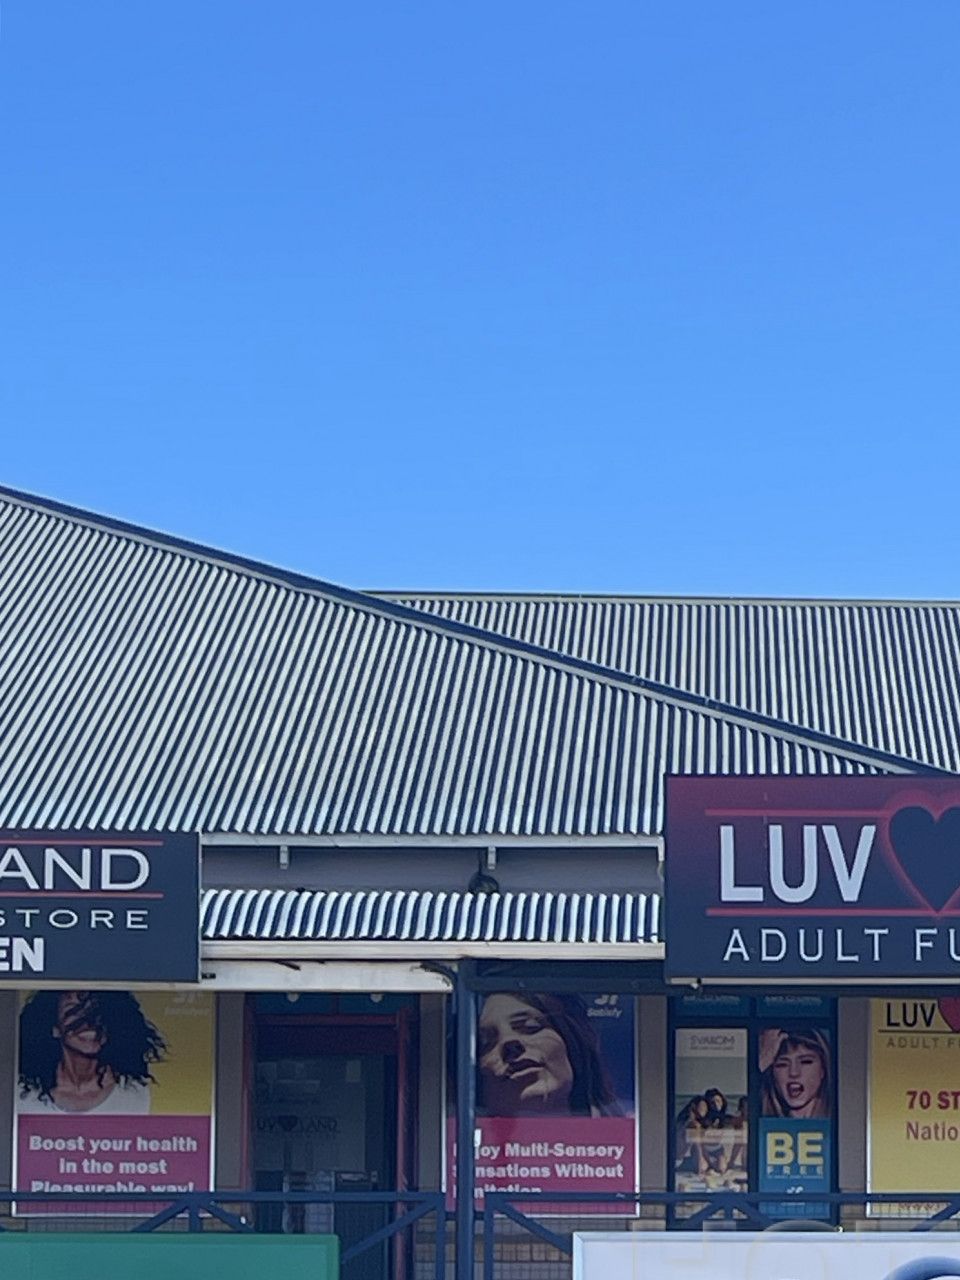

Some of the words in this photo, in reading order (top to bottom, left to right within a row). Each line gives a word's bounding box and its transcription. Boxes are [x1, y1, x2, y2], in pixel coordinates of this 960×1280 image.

[719, 823, 877, 903] LUV
[723, 926, 889, 962] ADULT
[886, 1001, 937, 1028] LUV
[886, 1035, 939, 1049] ADULT
[906, 1091, 932, 1110] 70
[29, 1135, 85, 1151] Boost
[89, 1138, 131, 1153] your
[136, 1137, 197, 1152] health
[504, 1142, 625, 1160] Multi-Sensory
[766, 1132, 824, 1165] BE
[82, 1159, 114, 1174] the
[119, 1160, 168, 1175] most
[453, 1164, 550, 1178] nsations
[554, 1163, 624, 1178] Without
